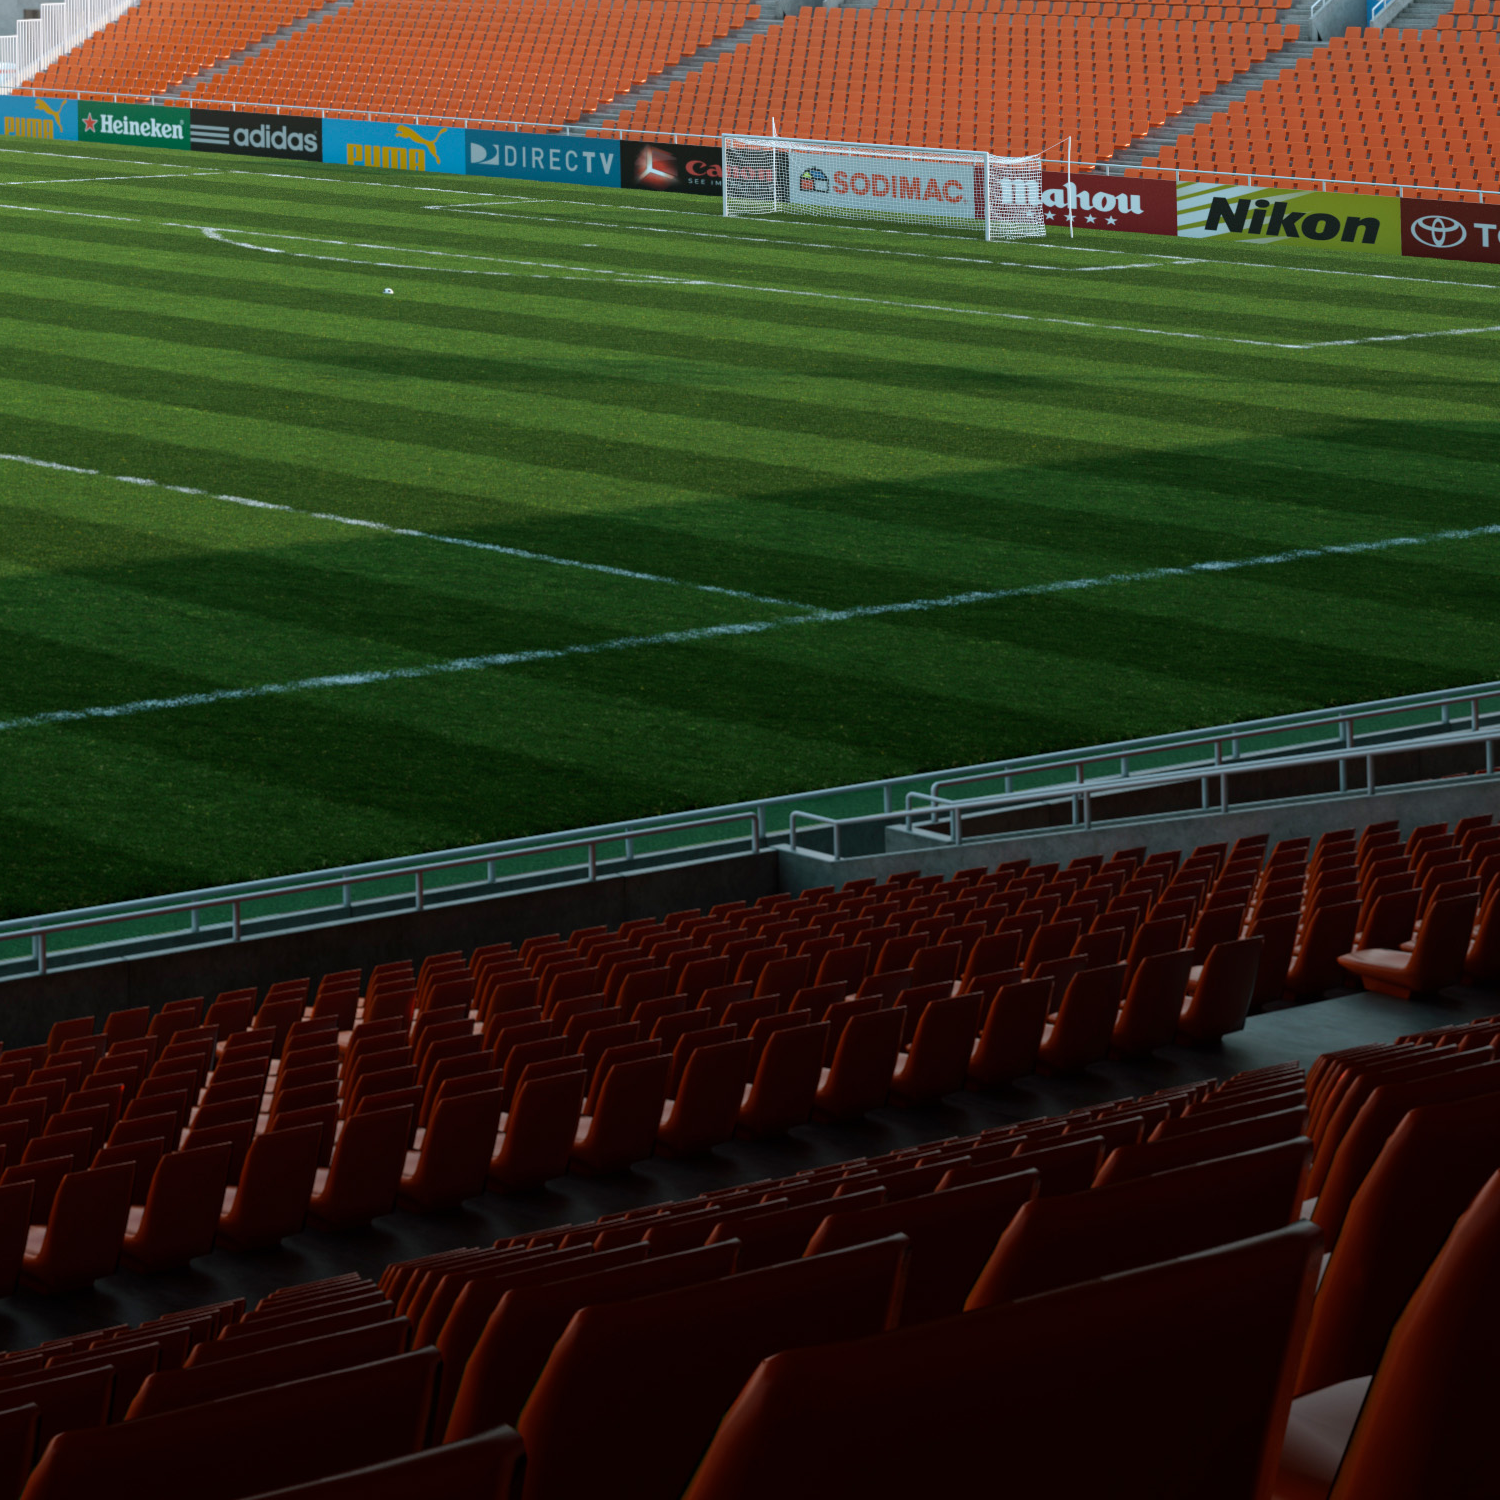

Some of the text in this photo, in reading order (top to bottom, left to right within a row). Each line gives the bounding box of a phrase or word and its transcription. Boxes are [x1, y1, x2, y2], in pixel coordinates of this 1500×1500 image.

[4, 116, 54, 139] PUMA
[100, 113, 184, 140] Heineken
[233, 125, 318, 153] adidas
[346, 143, 425, 171] PUMA
[504, 145, 614, 174] DIRECTV
[832, 170, 963, 204] SODIMAC
[1204, 196, 1380, 244] Nikon
